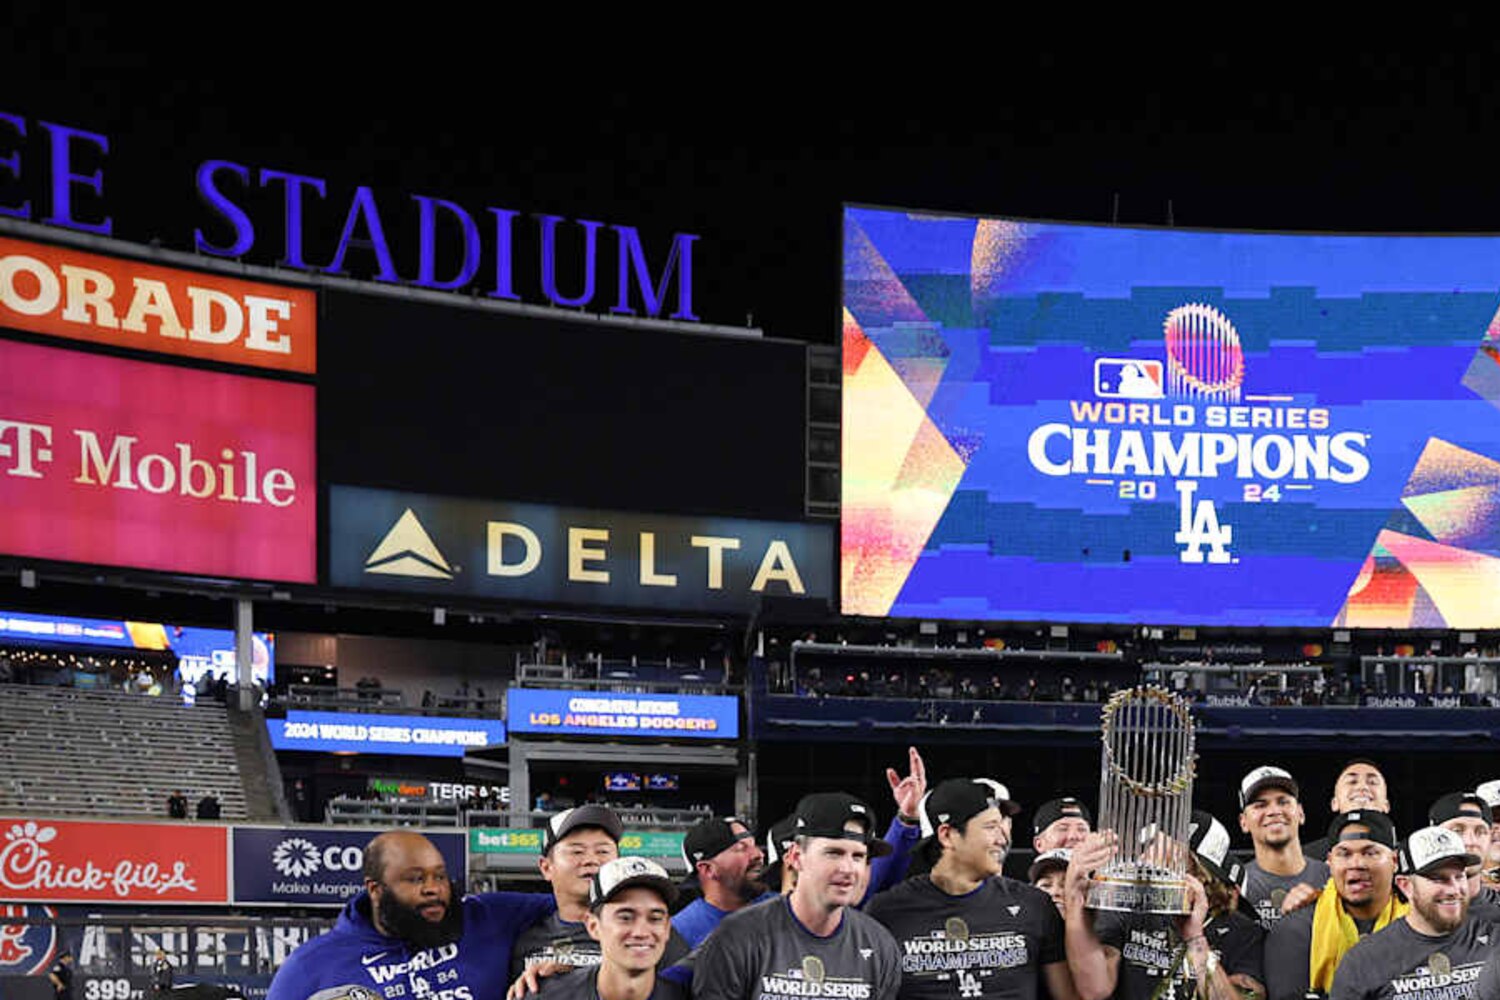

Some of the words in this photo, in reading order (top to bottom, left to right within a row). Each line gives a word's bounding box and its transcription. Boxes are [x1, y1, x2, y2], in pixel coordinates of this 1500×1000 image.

[193, 158, 702, 322] STADIUM
[0, 256, 292, 354] ORADE
[1071, 402, 1196, 428] WORLD
[1205, 406, 1330, 430] SERIES
[1027, 421, 1371, 483] CHAMPIONS
[75, 430, 295, 507] Mobile
[1119, 482, 1157, 500] 20
[1175, 481, 1233, 564] LA
[1243, 483, 1283, 503] 24
[486, 519, 807, 595] DELTA
[319, 724, 366, 742] WORLD
[367, 726, 410, 744] SERIES
[411, 728, 488, 748] CHAMPIONS
[529, 713, 561, 726] LOS
[563, 714, 639, 729] ANGELES
[639, 716, 718, 731] DODGERS
[478, 832, 539, 848] bet365
[0, 834, 197, 896] Chick-fil-A
[272, 881, 309, 894] Make
[904, 939, 966, 955] WORLD
[967, 935, 1026, 951] SERIES
[366, 942, 459, 985] WORLD
[902, 948, 1028, 973] CHAMPIONS
[85, 979, 131, 1000] 399
[384, 985, 405, 1000] 20
[410, 972, 432, 999] LA
[437, 969, 459, 985] 24
[762, 976, 821, 997] WORLD
[956, 970, 984, 998] LA
[1391, 975, 1450, 994] WORLD
[1451, 967, 1482, 985] SER
